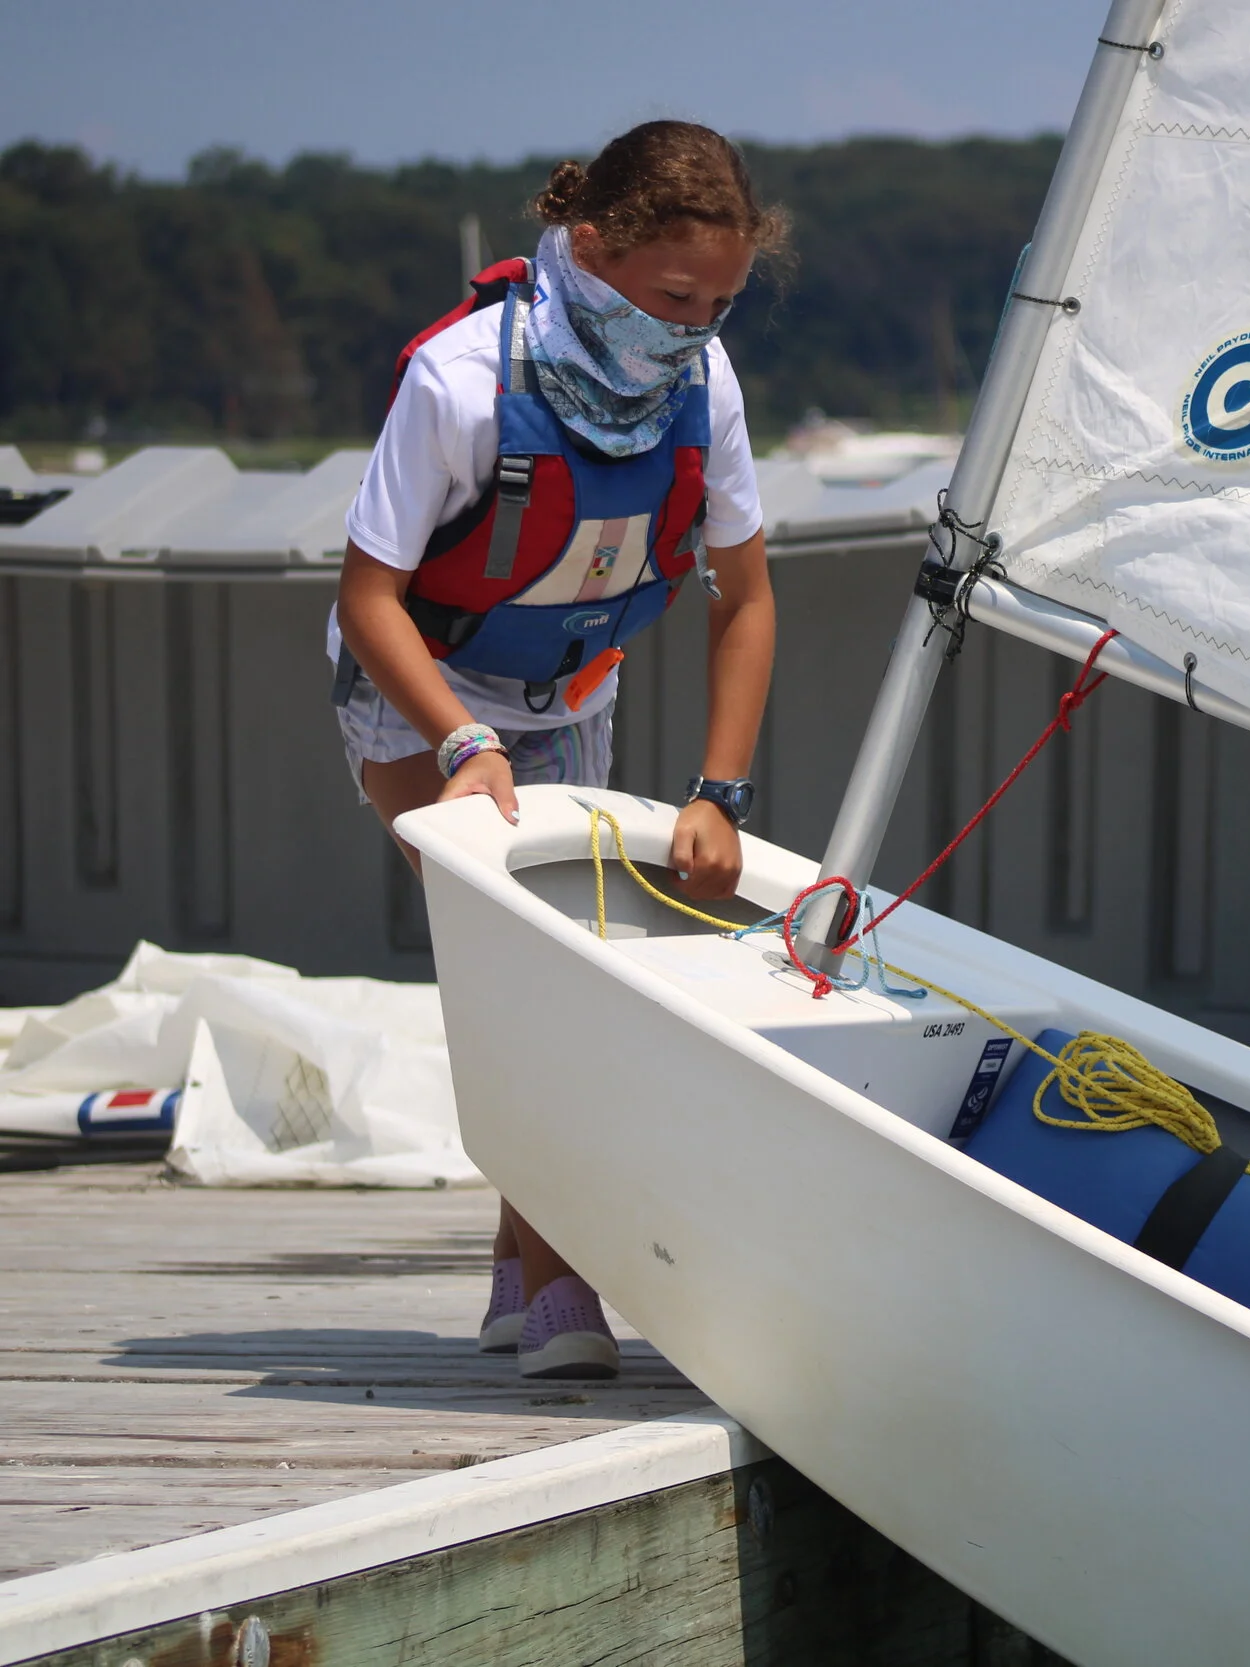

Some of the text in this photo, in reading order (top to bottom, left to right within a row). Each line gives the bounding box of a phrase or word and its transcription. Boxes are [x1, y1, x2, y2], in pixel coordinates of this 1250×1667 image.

[1194, 353, 1216, 378] NEIL
[1182, 394, 1191, 422] NEIL
[923, 1023, 942, 1038] USA
